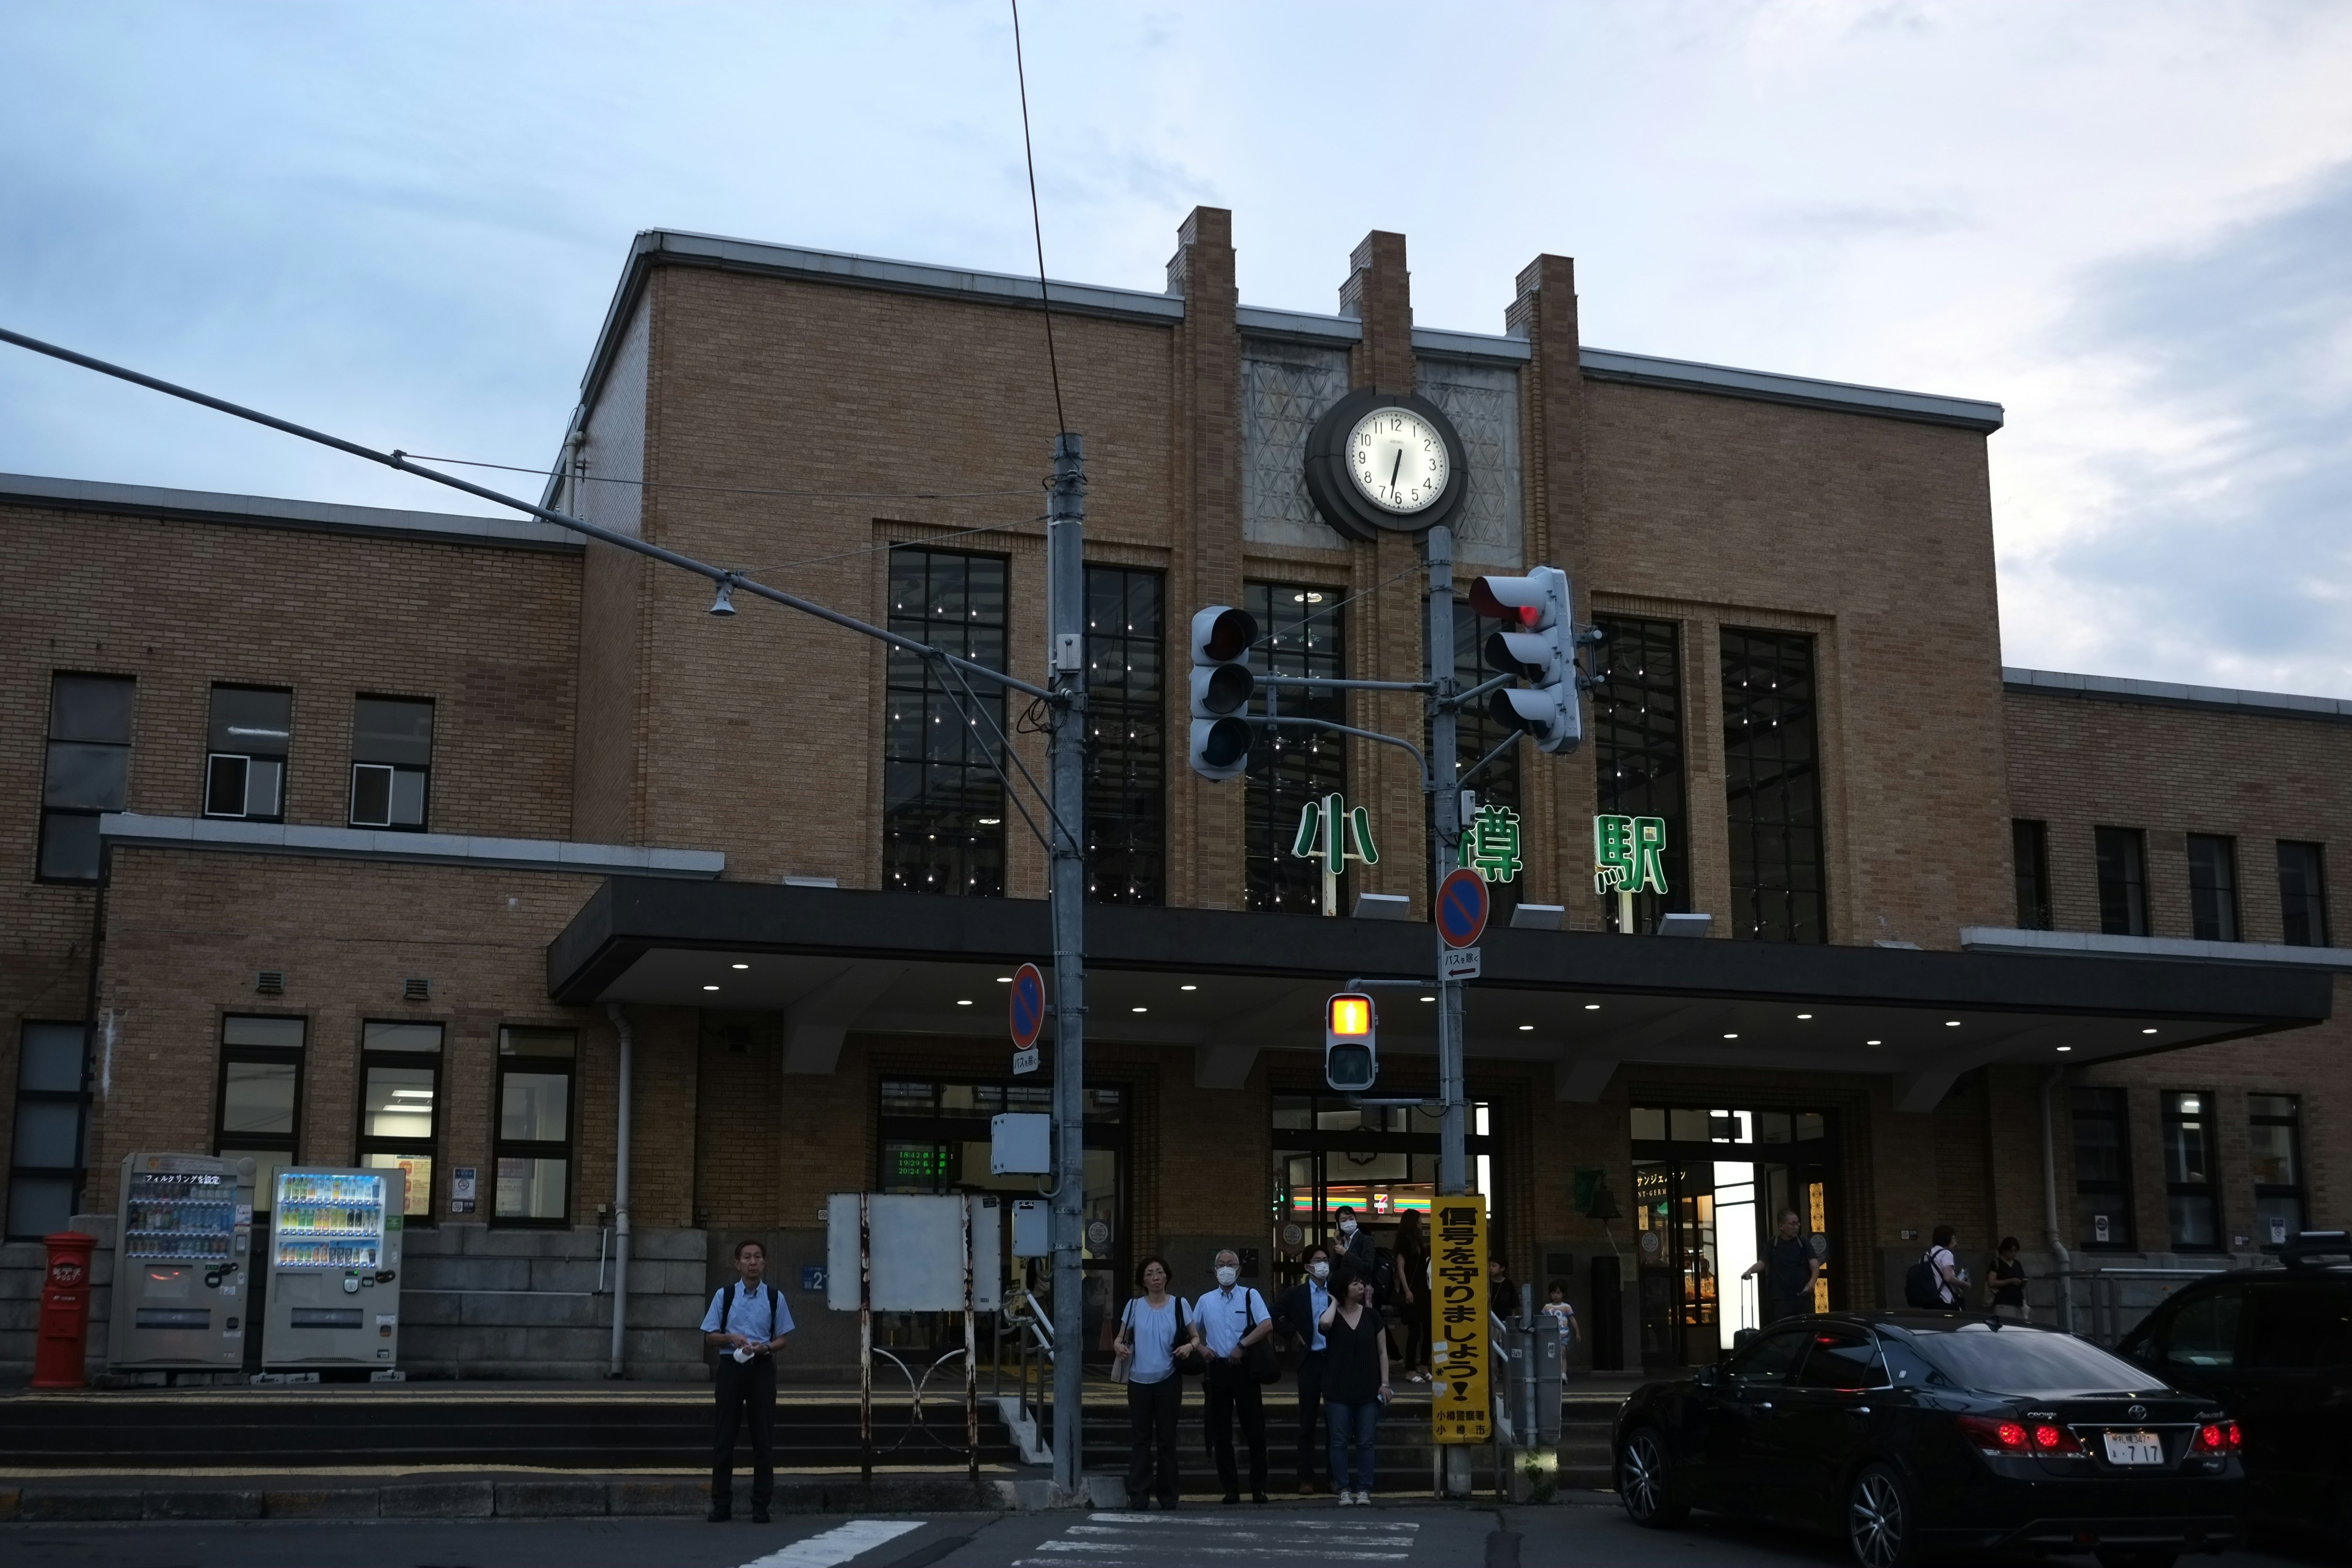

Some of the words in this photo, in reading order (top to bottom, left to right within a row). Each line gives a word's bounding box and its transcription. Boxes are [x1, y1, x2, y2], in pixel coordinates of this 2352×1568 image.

[1374, 422, 1383, 434] 11
[1391, 419, 1401, 432] 12
[1413, 425, 1416, 438] 1
[1361, 433, 1371, 446] 10
[1424, 439, 1431, 452] 2
[1359, 451, 1366, 464] 9
[1429, 458, 1436, 471] 3
[1364, 471, 1372, 483] 8
[1423, 477, 1432, 490] 4
[1378, 486, 1386, 498] 7
[1395, 491, 1402, 504] 6
[1411, 489, 1419, 502] 5
[1445, 953, 1478, 965] バスを除く
[1015, 1055, 1036, 1069] バスを除く
[1439, 1207, 1479, 1401] 信号を守りましょう!
[1437, 1410, 1484, 1421] 小樽警察署
[1437, 1425, 1485, 1435] 小樽市
